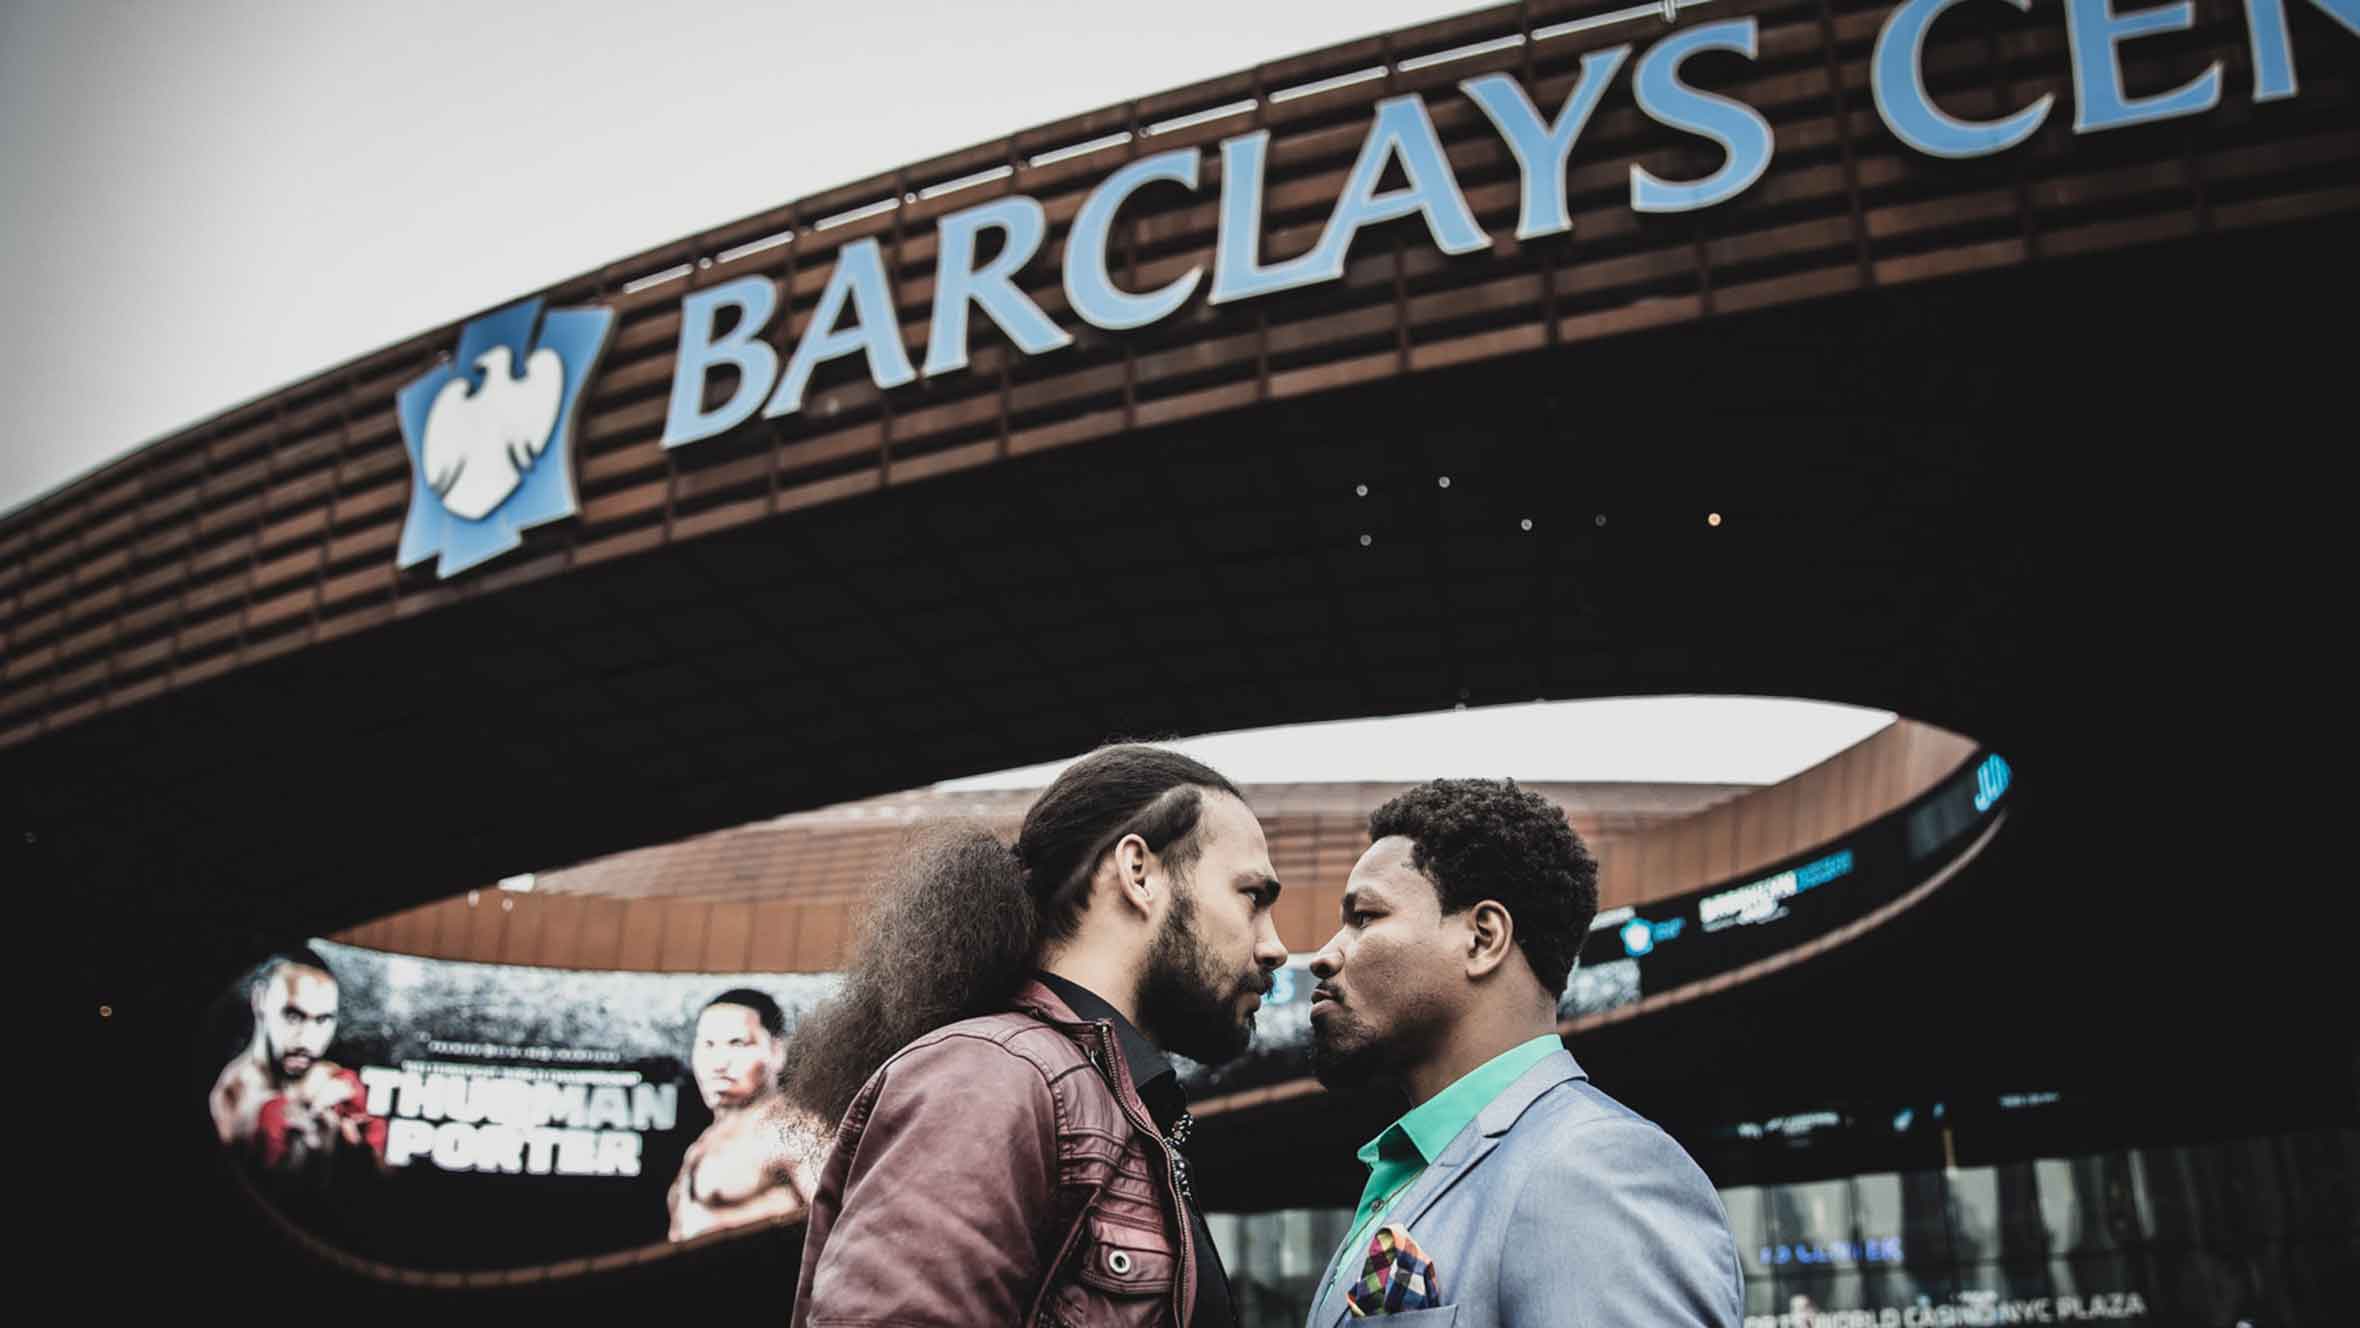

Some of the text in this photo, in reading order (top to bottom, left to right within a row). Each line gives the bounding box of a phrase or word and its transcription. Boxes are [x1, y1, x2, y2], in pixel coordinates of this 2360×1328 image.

[660, 17, 1774, 450] BARCLAYS
[385, 1116, 643, 1176] PORTER
[2056, 1293, 2147, 1320] PLAZA
